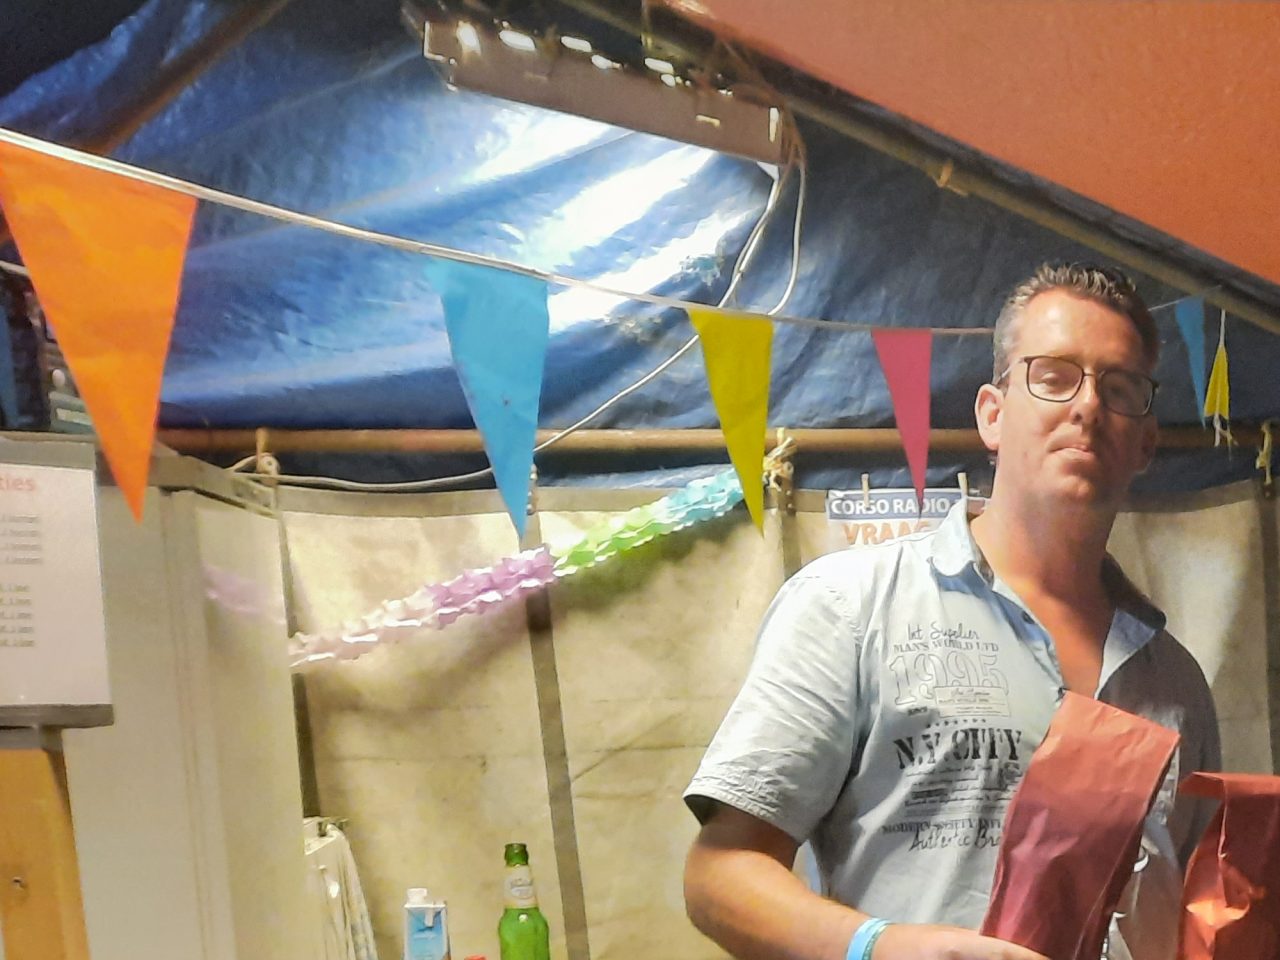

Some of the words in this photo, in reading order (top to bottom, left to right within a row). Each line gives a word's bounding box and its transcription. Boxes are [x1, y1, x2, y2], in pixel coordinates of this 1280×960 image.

[831, 499, 890, 515] CORSO
[894, 498, 951, 514] RADIO
[889, 650, 1009, 706] 1995
